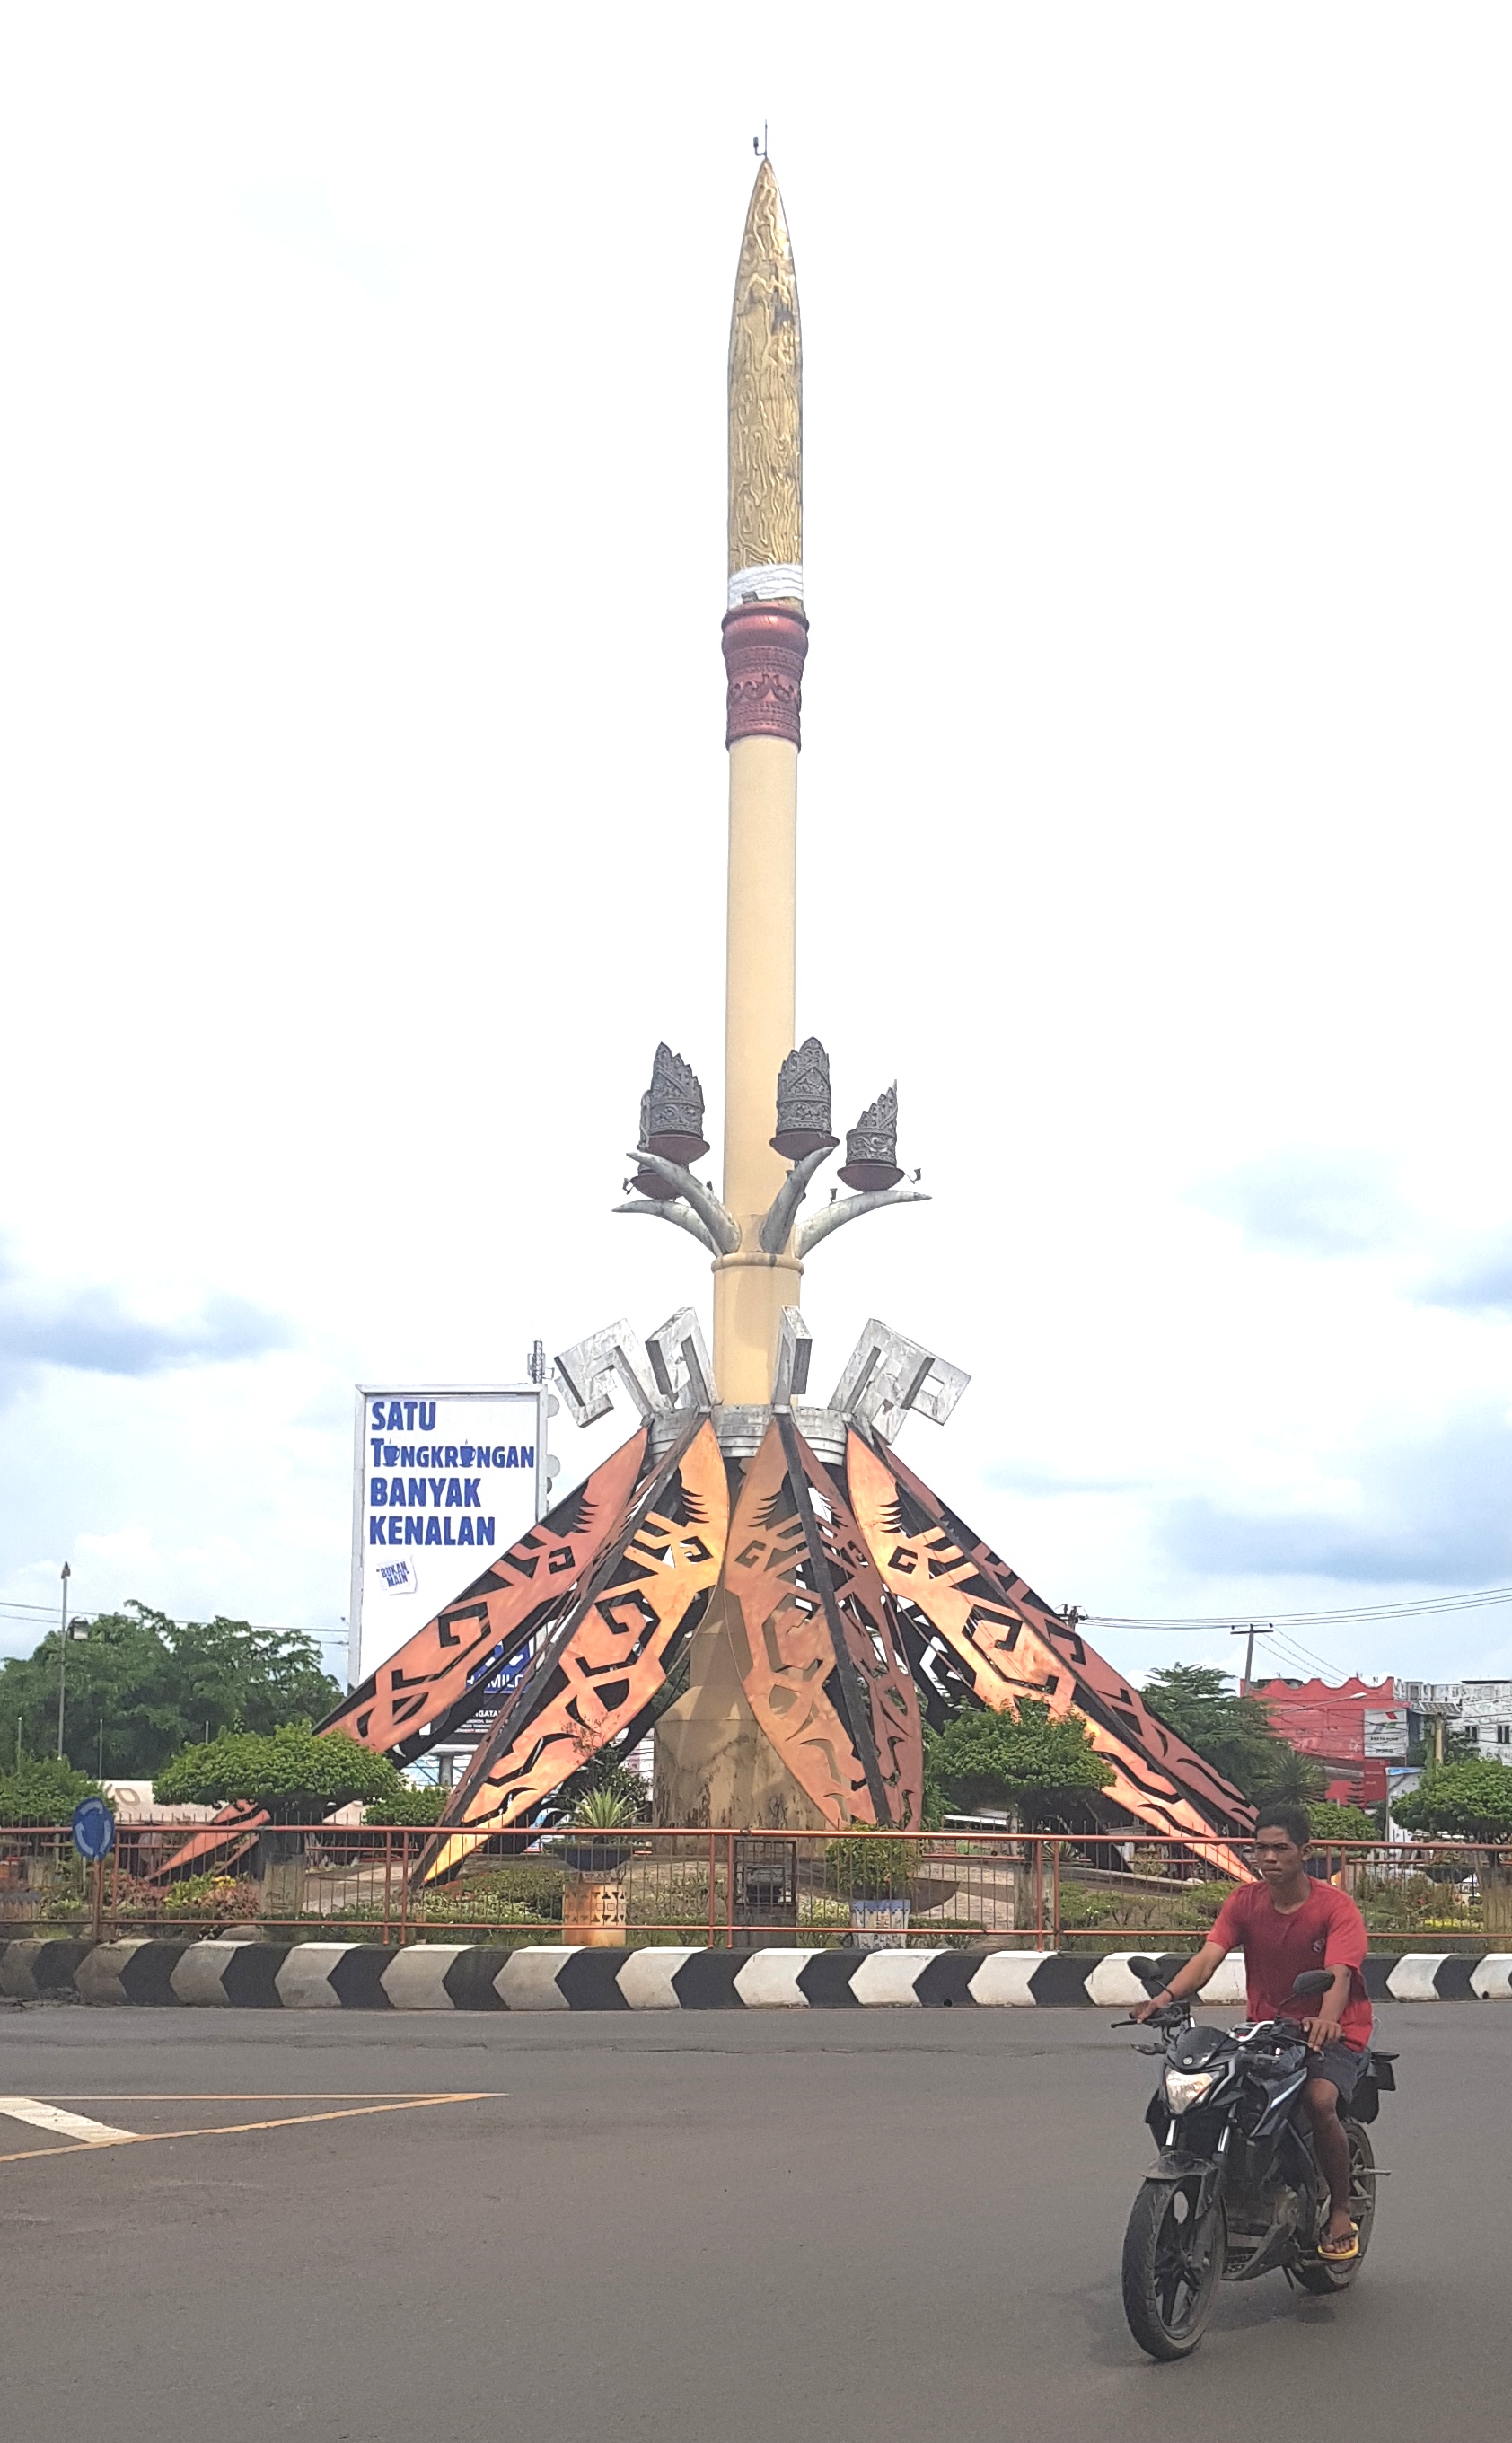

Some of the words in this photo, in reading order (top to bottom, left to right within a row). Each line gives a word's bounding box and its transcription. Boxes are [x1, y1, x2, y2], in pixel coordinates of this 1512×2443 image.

[371, 1402, 436, 1431] SATU
[370, 1477, 481, 1507] BANYAK
[369, 1516, 495, 1546] KENALAN
[380, 1560, 408, 1578] BUKAN
[386, 1572, 408, 1587] MAIN
